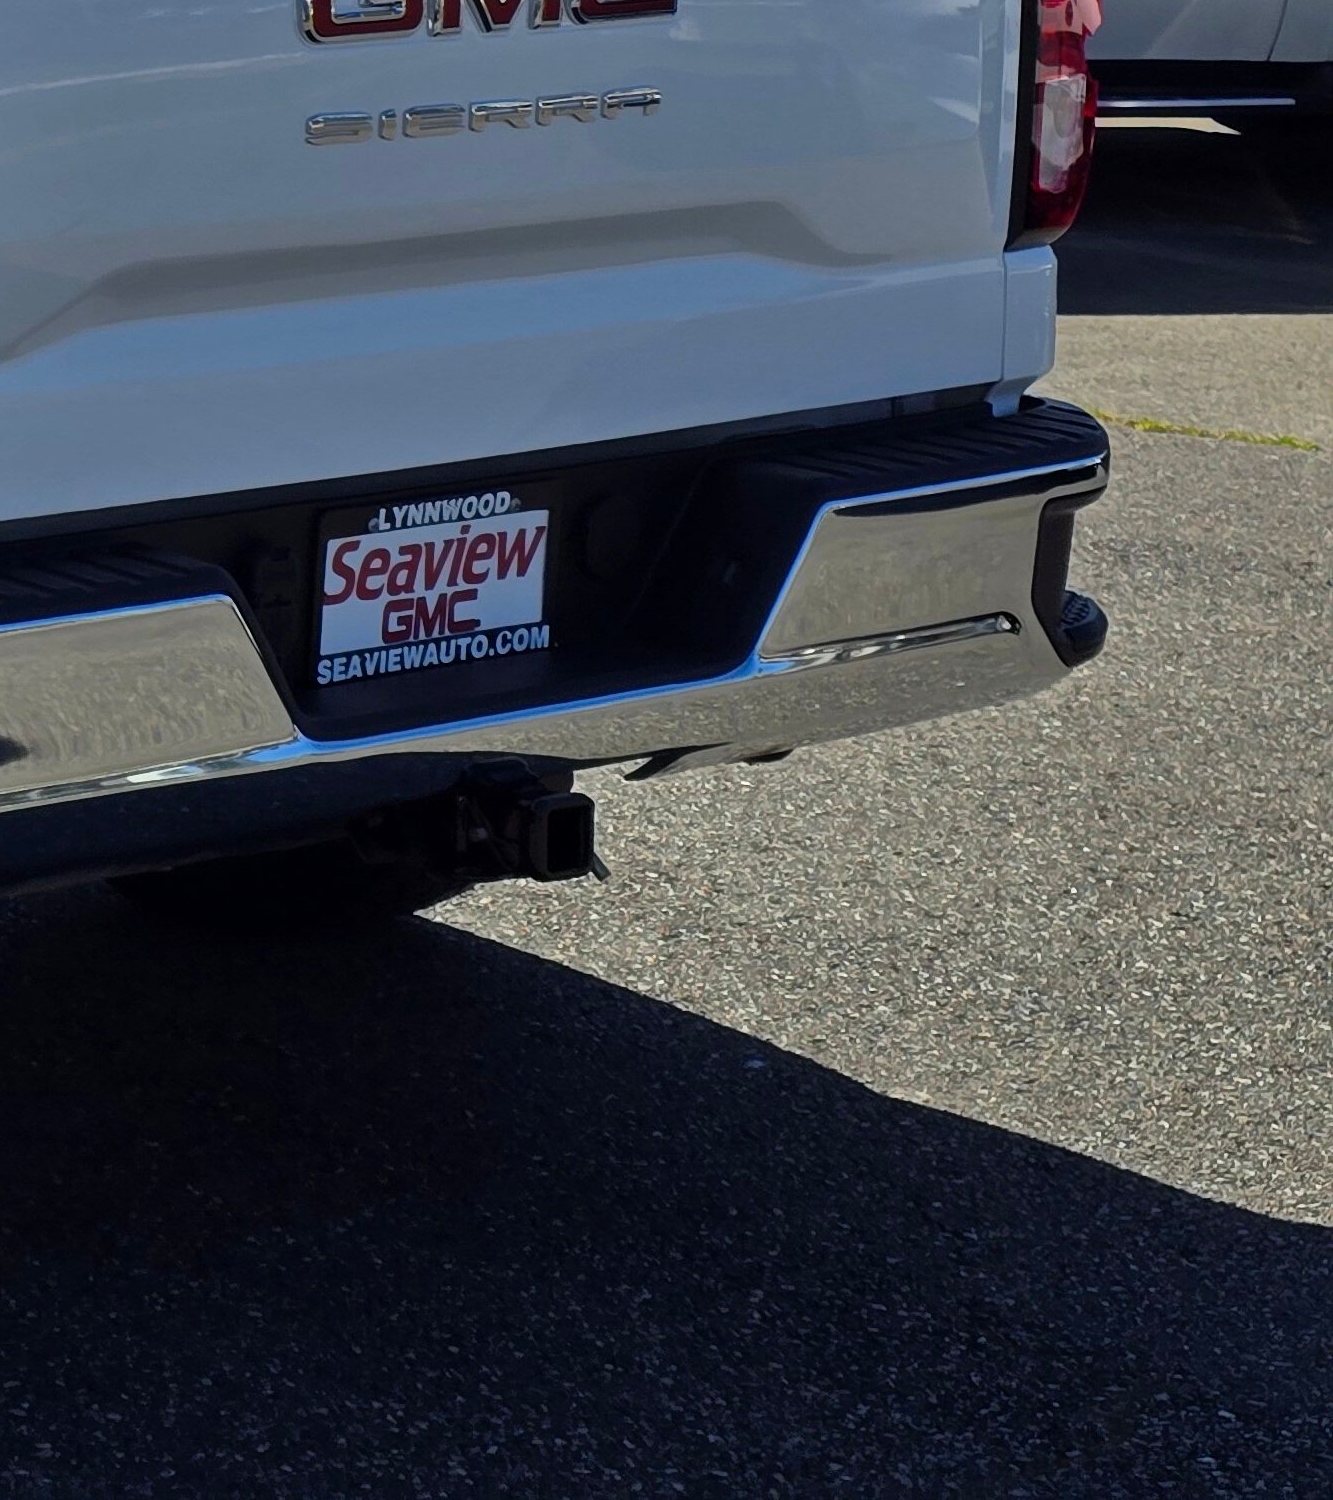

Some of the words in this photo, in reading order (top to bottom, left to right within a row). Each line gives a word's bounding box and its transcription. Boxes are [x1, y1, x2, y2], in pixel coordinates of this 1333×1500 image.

[305, 86, 662, 146] SIERRA
[378, 491, 511, 531] LYNNWOOD
[323, 524, 546, 606] Seaview
[381, 588, 480, 644] GMC
[317, 624, 550, 684] SEAVIEWAUTO.COM
